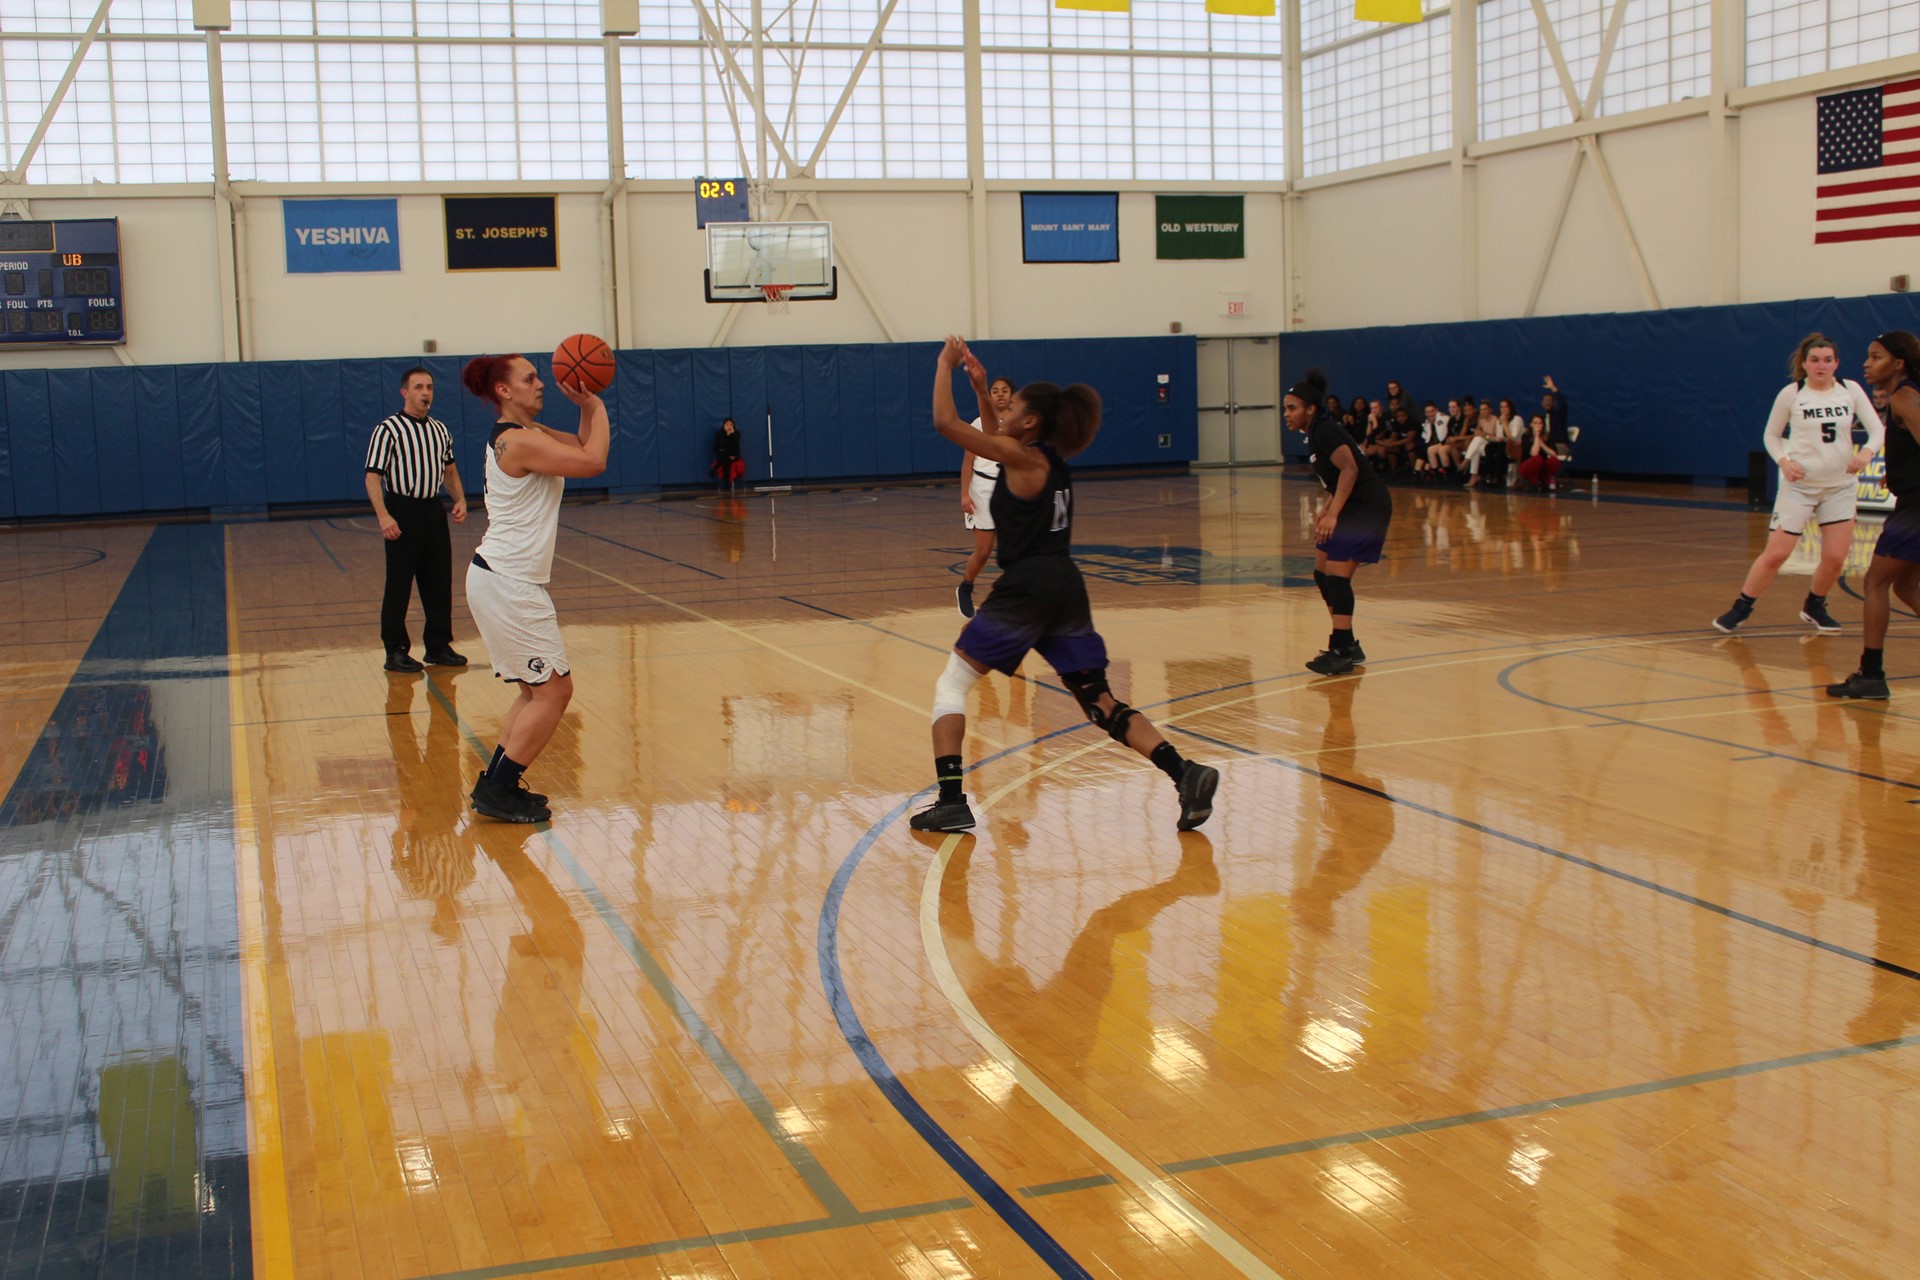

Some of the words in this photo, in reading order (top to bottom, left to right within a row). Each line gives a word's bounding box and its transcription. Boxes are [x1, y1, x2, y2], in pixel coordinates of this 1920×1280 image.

[455, 228, 476, 240] ST.
[482, 227, 549, 240] JOSEPH'S
[1030, 223, 1059, 232] MOUNT
[1062, 223, 1085, 232] SAINT
[1087, 223, 1111, 232] MARY
[1160, 222, 1181, 233] OLD
[1185, 222, 1239, 233] WESTBURY
[295, 227, 391, 246] YESHIVA
[0, 261, 29, 271] PERIOD
[62, 253, 82, 266] UB
[7, 300, 29, 309] FOUL
[37, 299, 54, 308] PTS
[88, 298, 115, 307] FOULS
[1228, 301, 1245, 315] EXIT
[1803, 405, 1849, 419] MERCY
[1821, 422, 1836, 444] 5
